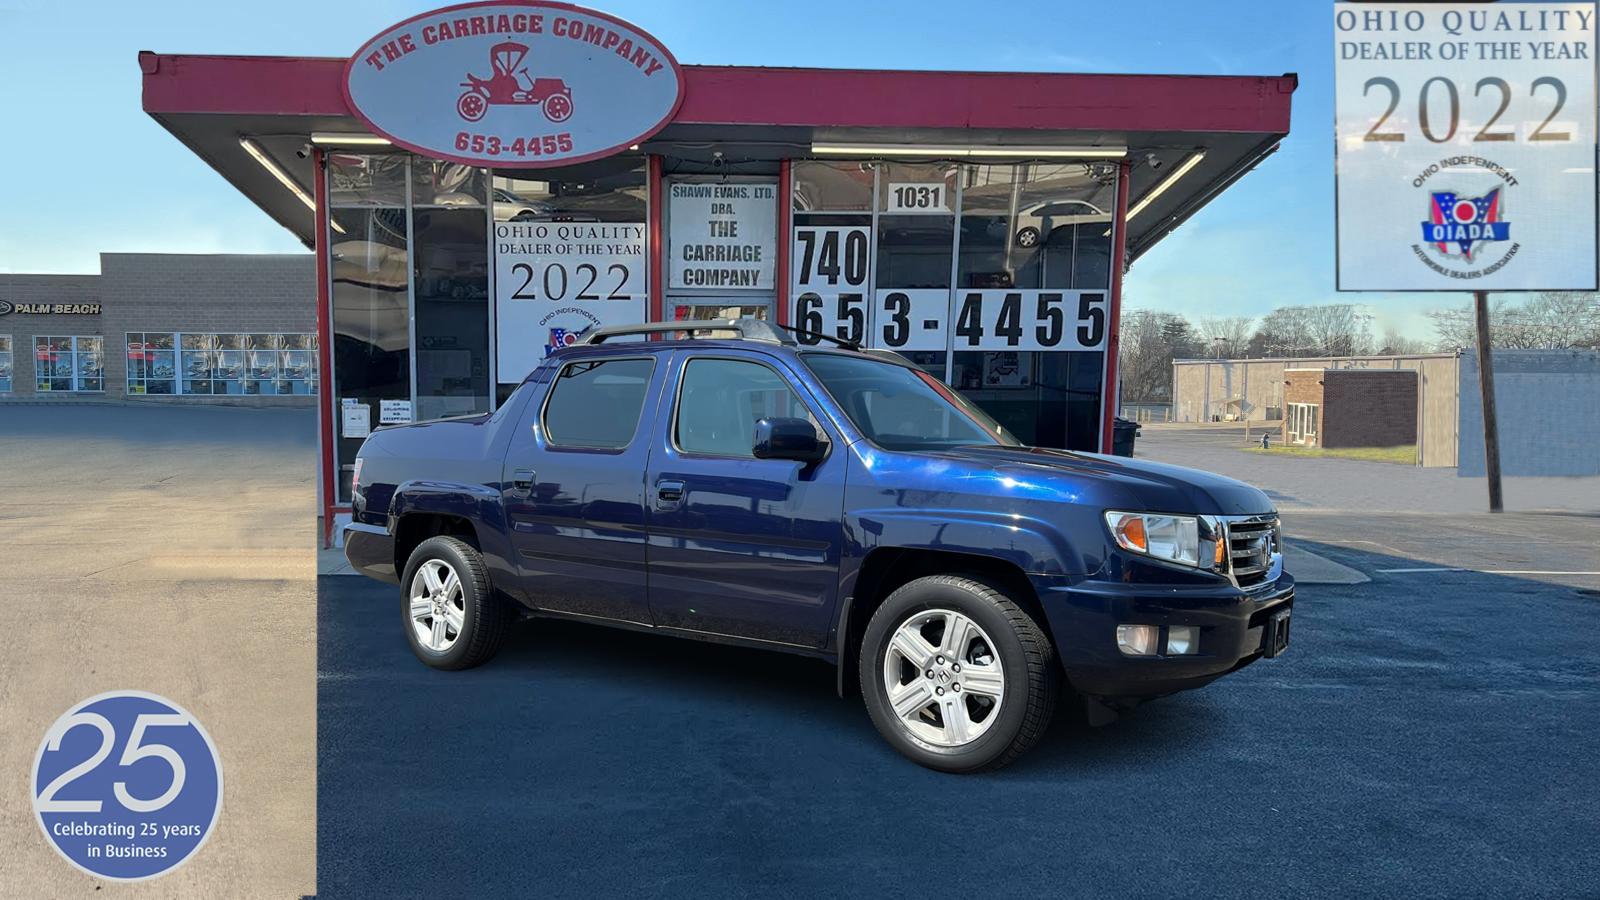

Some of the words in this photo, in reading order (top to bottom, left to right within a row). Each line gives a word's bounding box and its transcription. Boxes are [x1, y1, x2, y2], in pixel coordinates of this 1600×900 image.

[1336, 10, 1425, 32] OHIO
[1442, 10, 1593, 35] QUALITY
[366, 33, 416, 71] THE
[422, 14, 544, 45] CARRIAGE
[552, 17, 664, 77] COMPANY
[1340, 42, 1433, 60] DEALER
[1439, 42, 1469, 60] OF
[1475, 42, 1522, 59] THE
[1528, 42, 1589, 59] YEAR
[1363, 76, 1571, 143] 2022
[455, 132, 573, 156] 653-4455
[1413, 164, 1439, 188] OHIO
[1440, 156, 1519, 187] INDEPENDENT
[673, 185, 712, 198] SHAWN
[754, 186, 775, 199] LTD.
[894, 187, 940, 208] 1031
[711, 203, 736, 215] DBA.
[497, 226, 548, 238] OHIO
[557, 226, 644, 241] QUALITY
[708, 220, 738, 237] THE
[1433, 224, 1495, 240] OIADA
[499, 243, 552, 254] DEALER
[555, 244, 573, 254] OF
[576, 244, 603, 254] THE
[606, 244, 641, 255] YEAR
[683, 244, 762, 262] CARRIAGE
[797, 230, 867, 286] 740
[1449, 268, 1482, 279] DEALERS
[1483, 242, 1521, 276] ASSOCIATION
[511, 263, 631, 300] 2022
[683, 269, 760, 286] COMPANY
[15, 304, 51, 314] PALM
[539, 312, 556, 326] OHIO
[555, 307, 601, 326] INDEPENDENT
